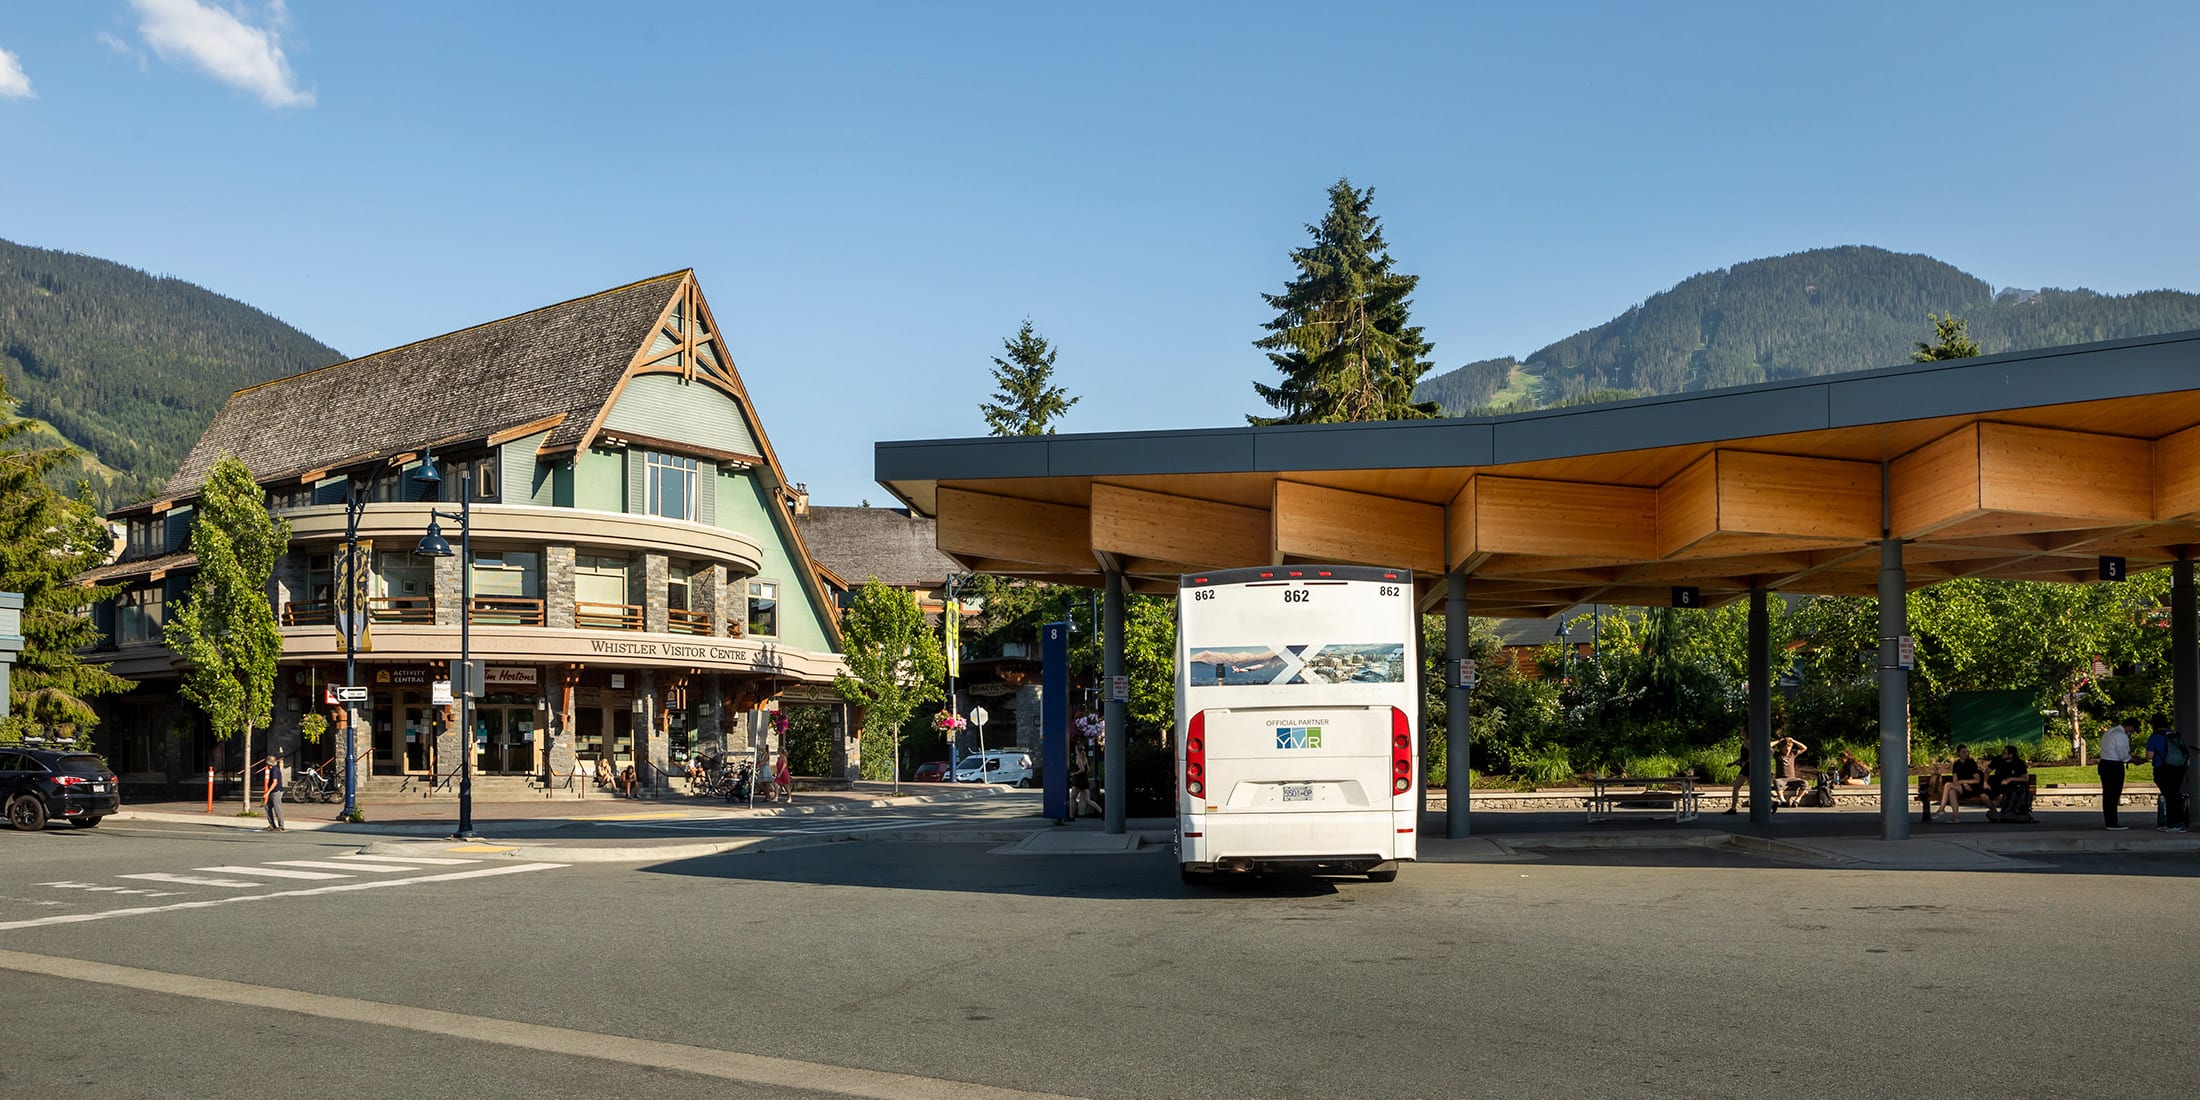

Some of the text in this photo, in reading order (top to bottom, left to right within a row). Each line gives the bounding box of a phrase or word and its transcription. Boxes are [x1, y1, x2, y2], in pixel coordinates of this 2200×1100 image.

[2109, 562, 2116, 577] 5
[1195, 589, 1216, 601] 862
[1284, 590, 1310, 603] 862
[1379, 586, 1400, 597] 862
[1682, 591, 1690, 604] 6
[1050, 628, 1058, 640] 8
[591, 640, 747, 660] WHISTLER VISITOR CENTRE
[499, 669, 535, 681] Hortons
[1276, 736, 1321, 749] YVR
